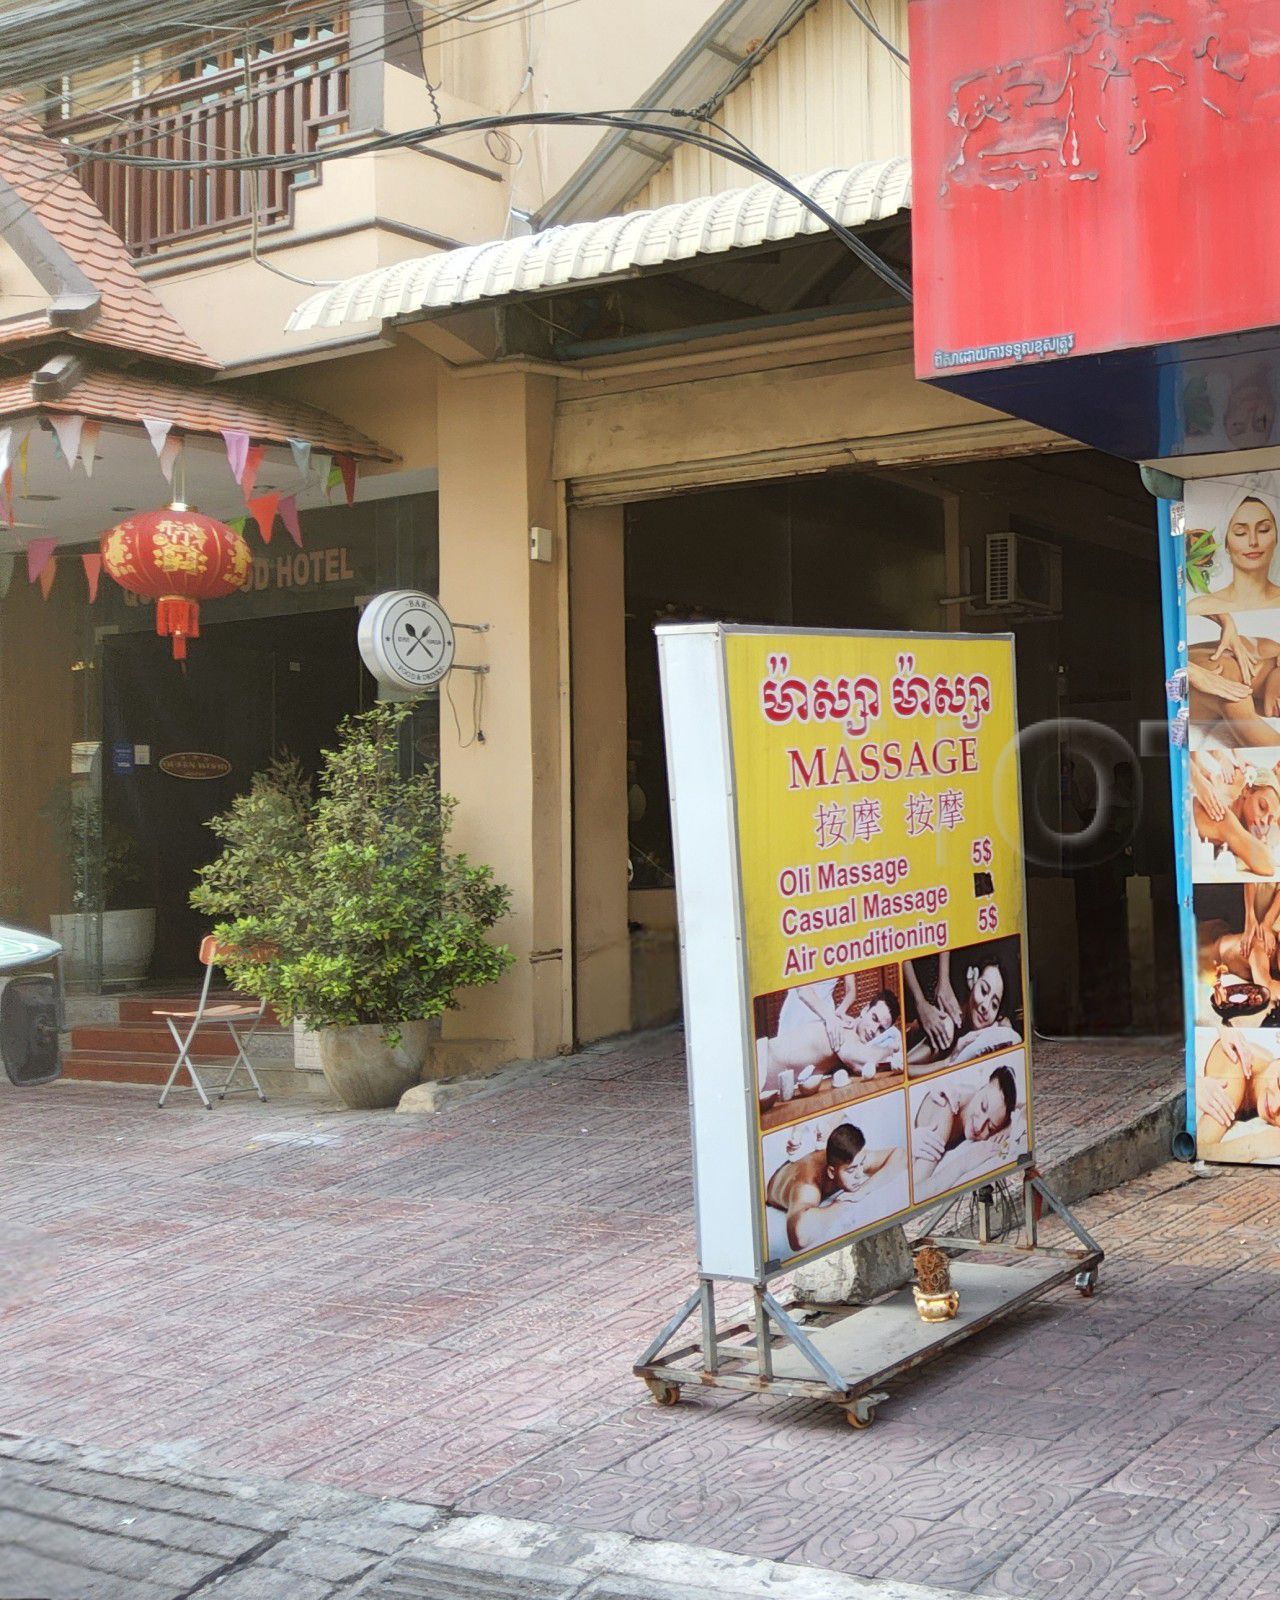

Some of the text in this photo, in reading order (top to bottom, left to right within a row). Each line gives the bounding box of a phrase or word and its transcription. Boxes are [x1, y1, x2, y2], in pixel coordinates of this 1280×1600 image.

[276, 547, 354, 589] HOTEL
[408, 600, 427, 608] BAR
[397, 666, 416, 680] FOOD
[787, 737, 979, 788] MASSAGE
[815, 789, 964, 848] 按摩 按摩
[972, 838, 992, 866] 5$
[780, 858, 908, 896] Oli Massage
[782, 886, 948, 936] Casual Massage
[979, 905, 998, 933] 5$
[784, 922, 947, 976] Air conditioning
